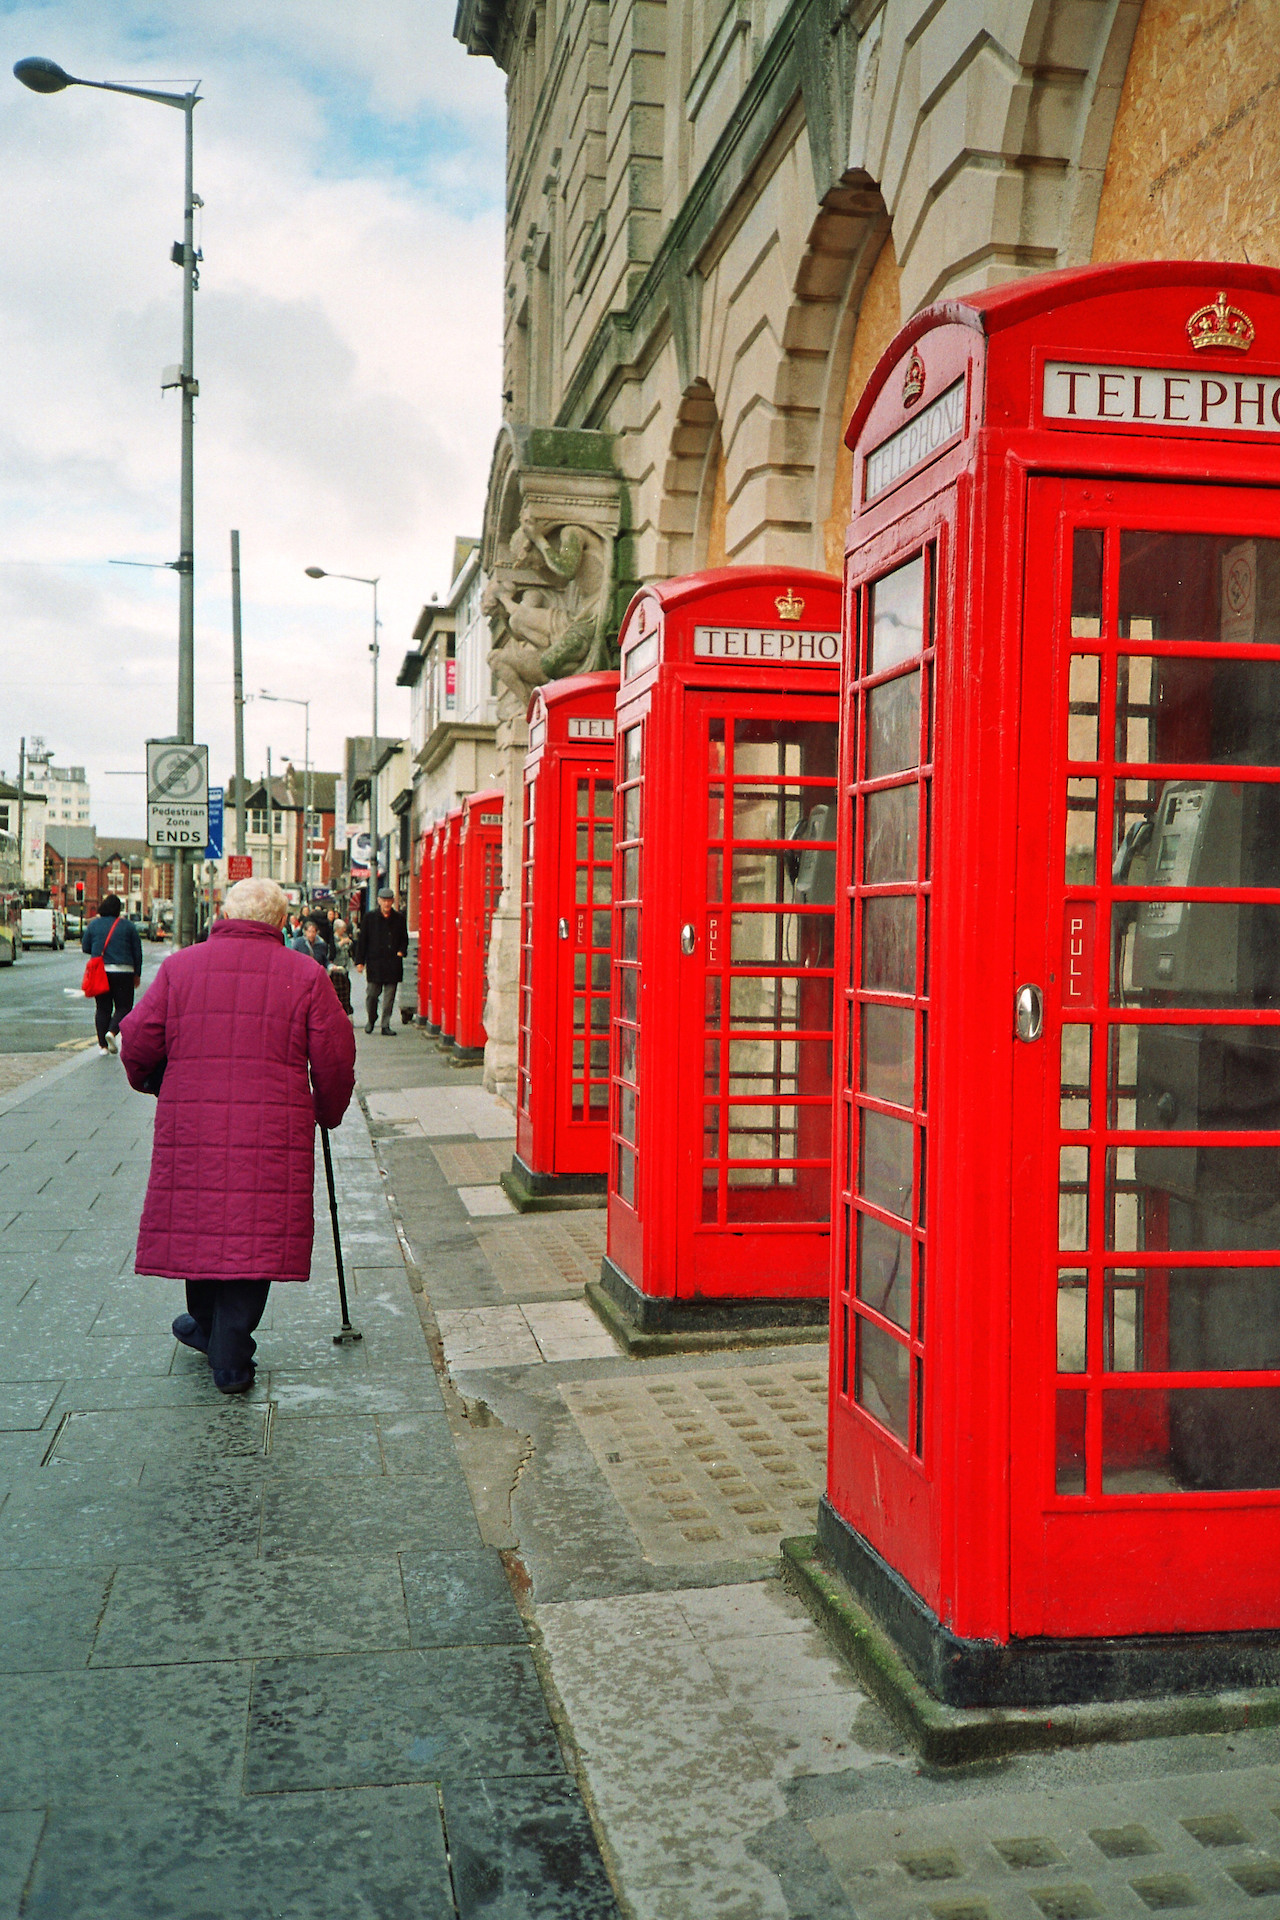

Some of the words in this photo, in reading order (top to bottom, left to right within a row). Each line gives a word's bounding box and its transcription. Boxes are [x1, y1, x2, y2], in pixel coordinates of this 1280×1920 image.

[1056, 370, 1280, 426] TELEPH
[871, 385, 965, 494] TELEPHONE
[702, 630, 838, 660] TELEPHO
[572, 719, 615, 737] TEL
[152, 806, 205, 816] Pedestrian
[166, 817, 190, 827] Zone
[156, 830, 201, 843] ENDS
[709, 919, 718, 961] PULL
[1069, 918, 1084, 996] PULL
